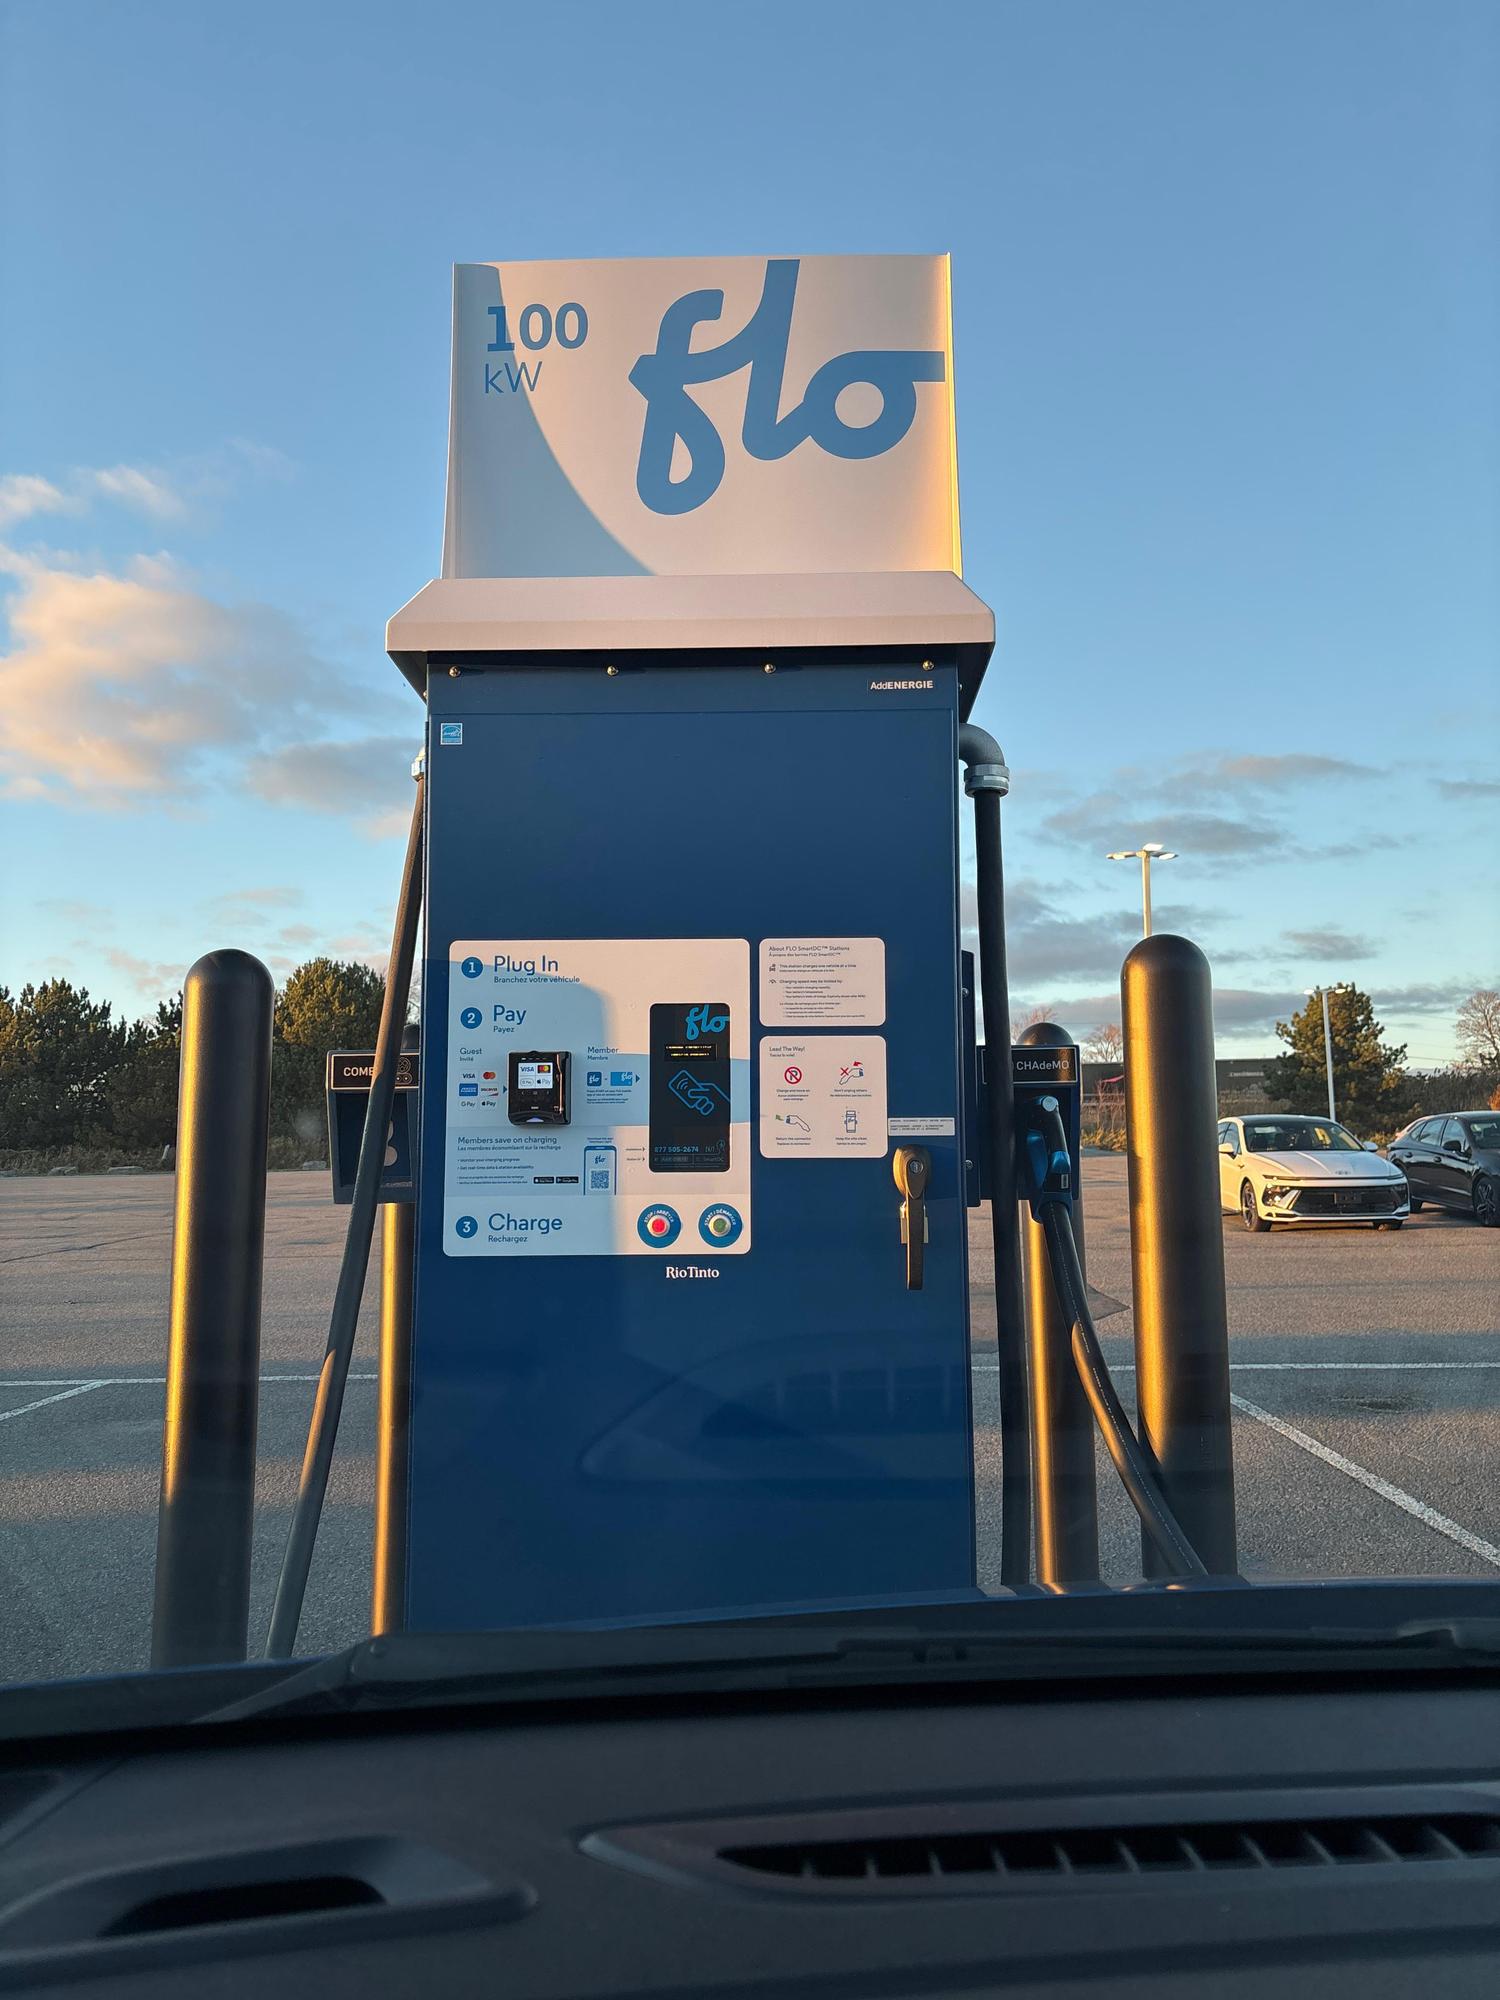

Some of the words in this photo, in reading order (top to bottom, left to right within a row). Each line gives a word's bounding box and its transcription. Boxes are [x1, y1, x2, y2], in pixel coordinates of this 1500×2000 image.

[487, 302, 589, 352] 100
[485, 361, 542, 393] kW
[628, 259, 945, 516] flo
[870, 680, 934, 690] AddENERGIE
[468, 962, 476, 973] 1
[494, 955, 535, 976] Plug
[542, 955, 558, 972] In
[467, 1013, 476, 1024] 2
[493, 1005, 527, 1025] Pay
[685, 1004, 730, 1041] flo
[587, 1046, 619, 1054] Member
[1016, 1060, 1070, 1071] CHAdeMO
[524, 1136, 557, 1145] charging
[462, 1221, 471, 1233] 3
[488, 1213, 563, 1234] Charge
[488, 1235, 528, 1243] Rechargez
